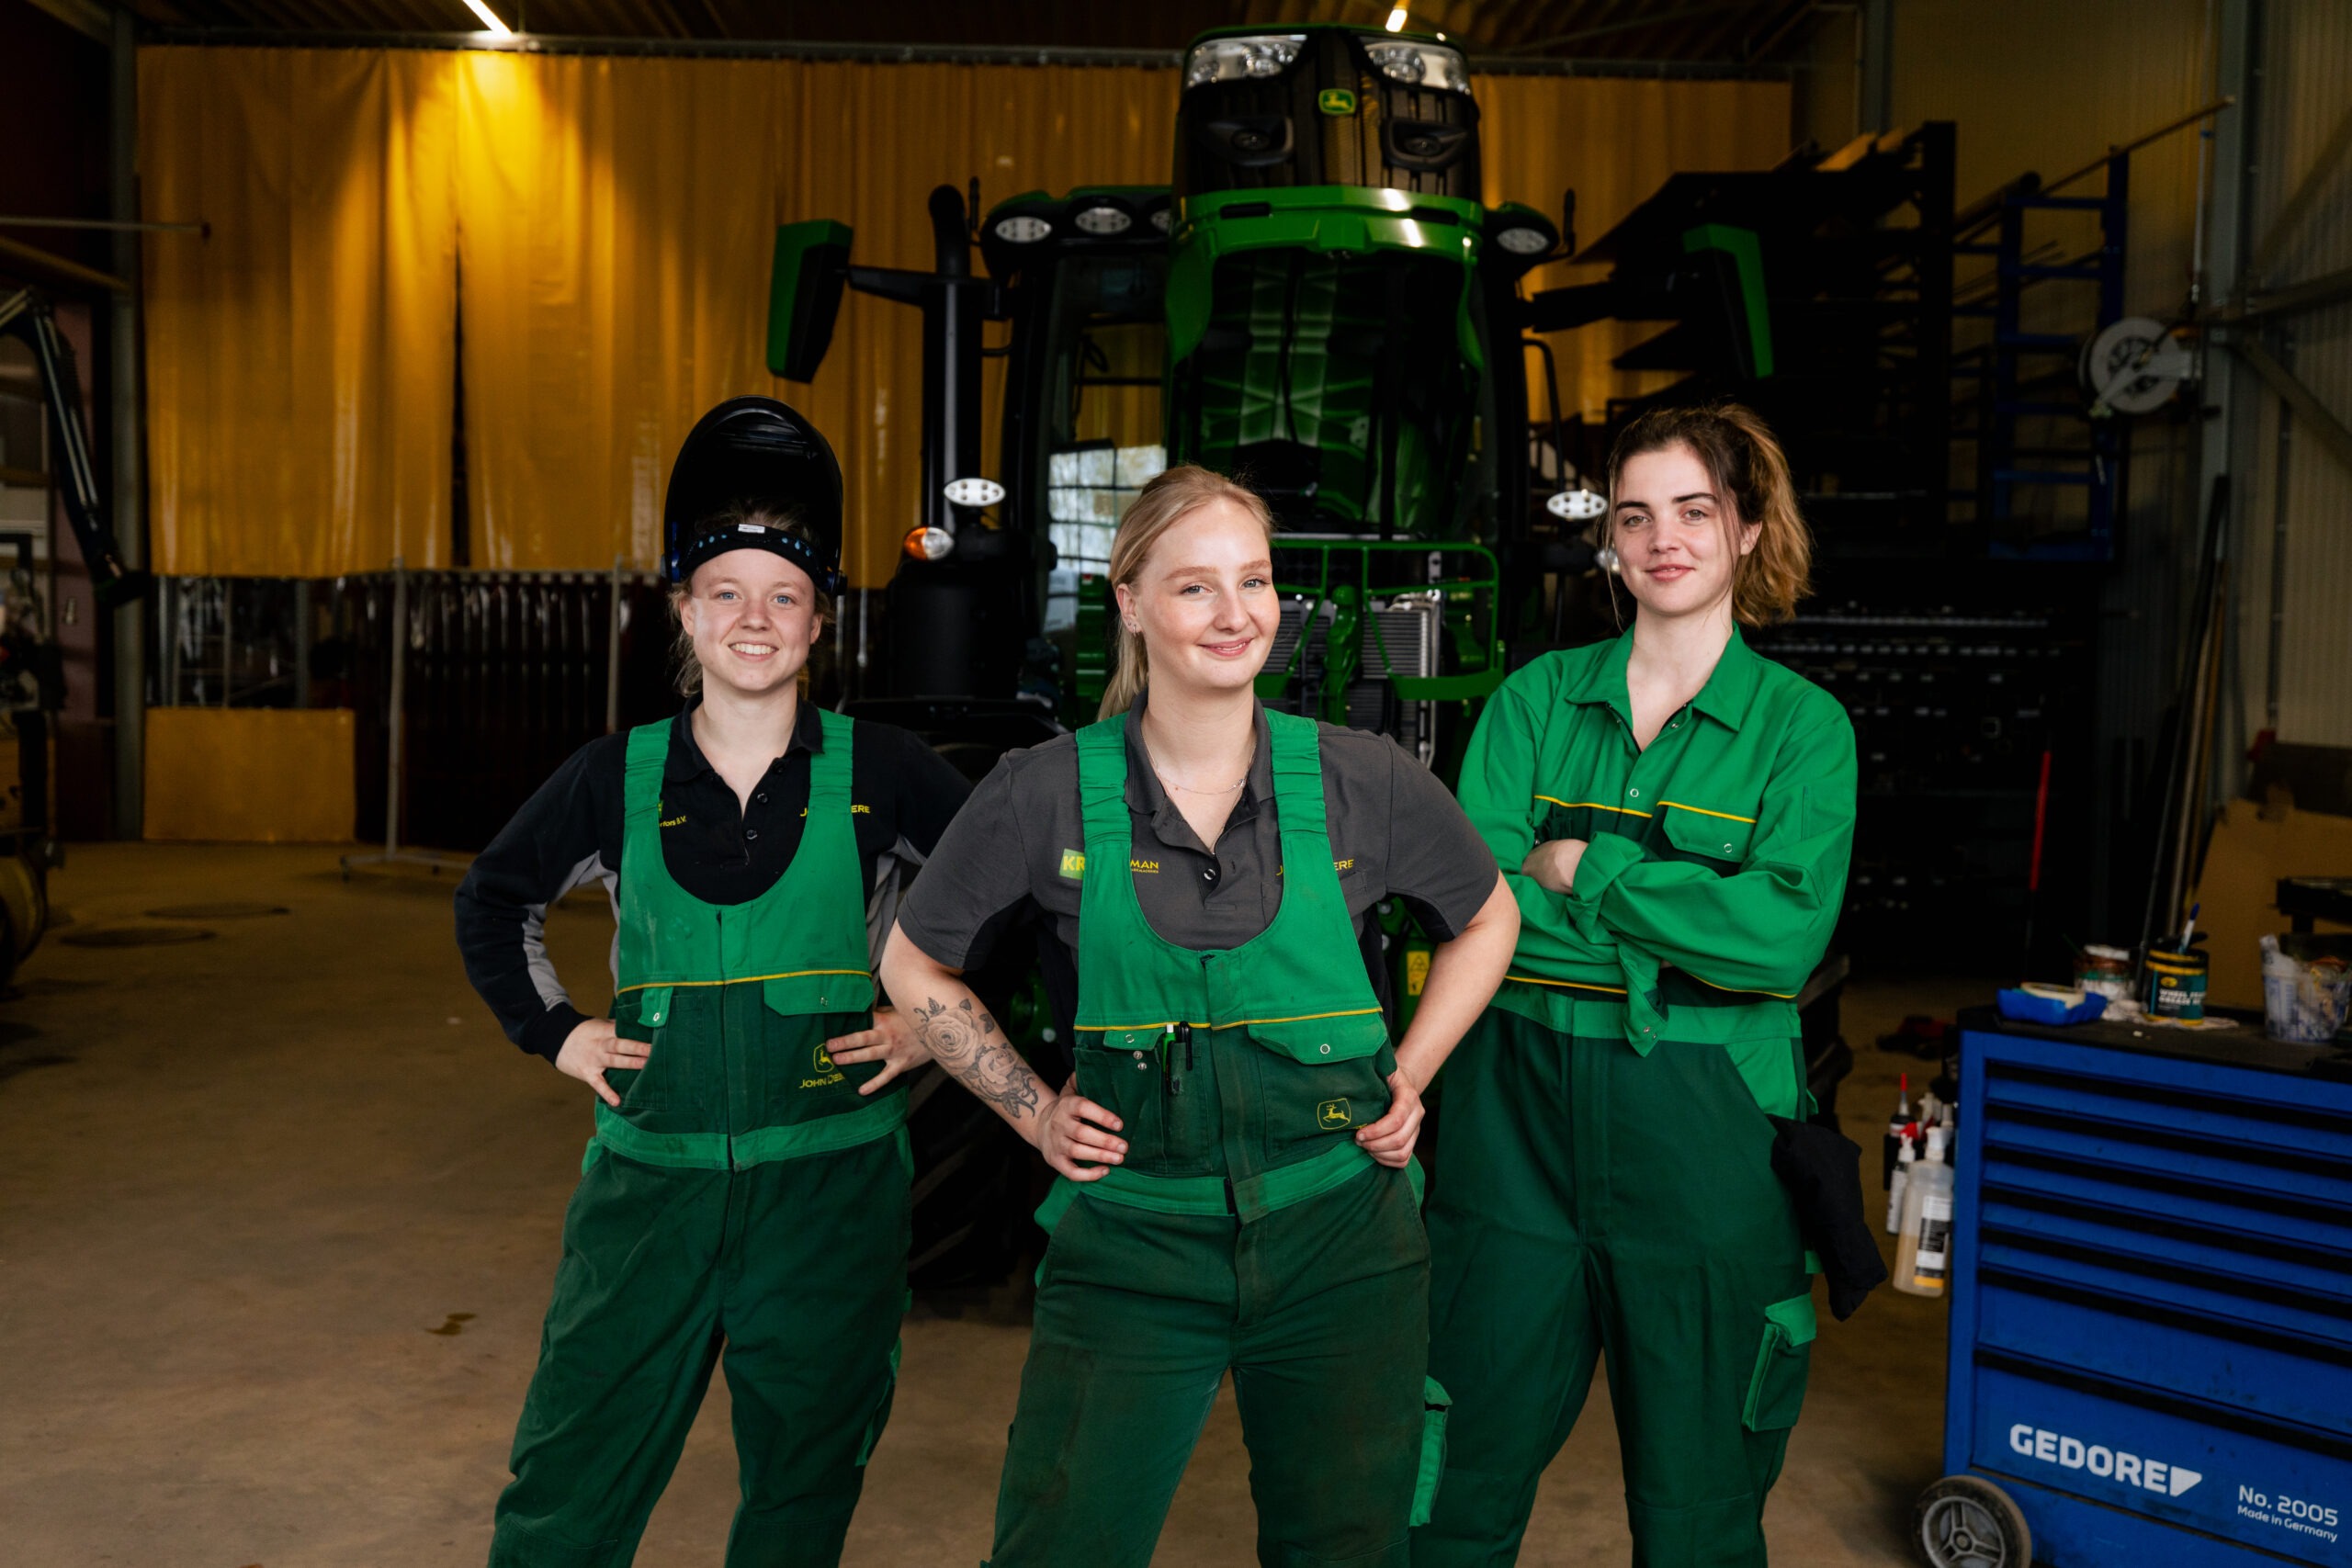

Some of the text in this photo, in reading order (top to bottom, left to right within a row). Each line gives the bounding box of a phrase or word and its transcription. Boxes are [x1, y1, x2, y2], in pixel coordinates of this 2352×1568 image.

[798, 1077, 827, 1089] JOHN
[2009, 1423, 2169, 1495] GEDORE
[2237, 1505, 2338, 1543] Made in Germany
[2238, 1483, 2338, 1527] No. 2005
